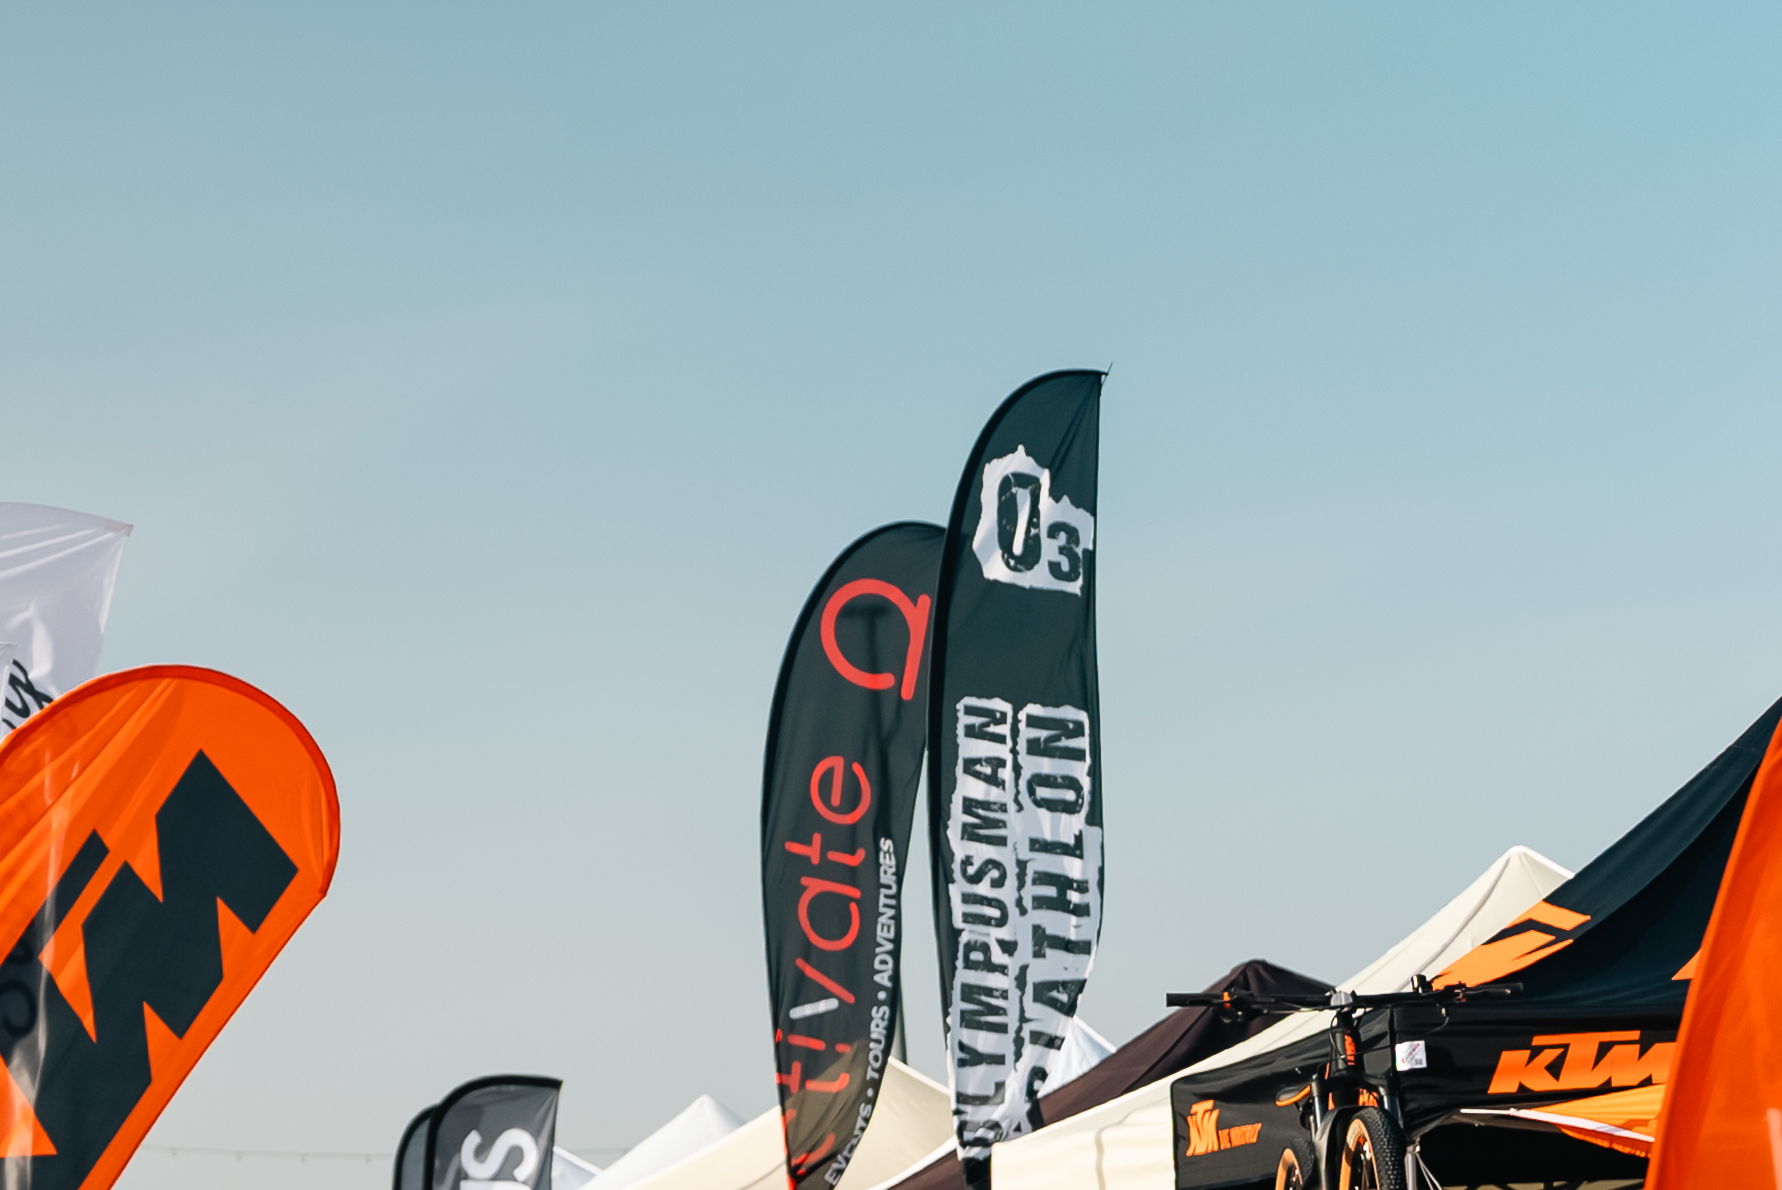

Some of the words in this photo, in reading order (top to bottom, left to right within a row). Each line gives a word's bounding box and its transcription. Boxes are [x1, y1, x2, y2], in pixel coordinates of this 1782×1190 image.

[873, 837, 899, 989] ADVENTURES
[866, 1005, 891, 1080] TOURS
[1487, 1030, 1678, 1094] KTM
